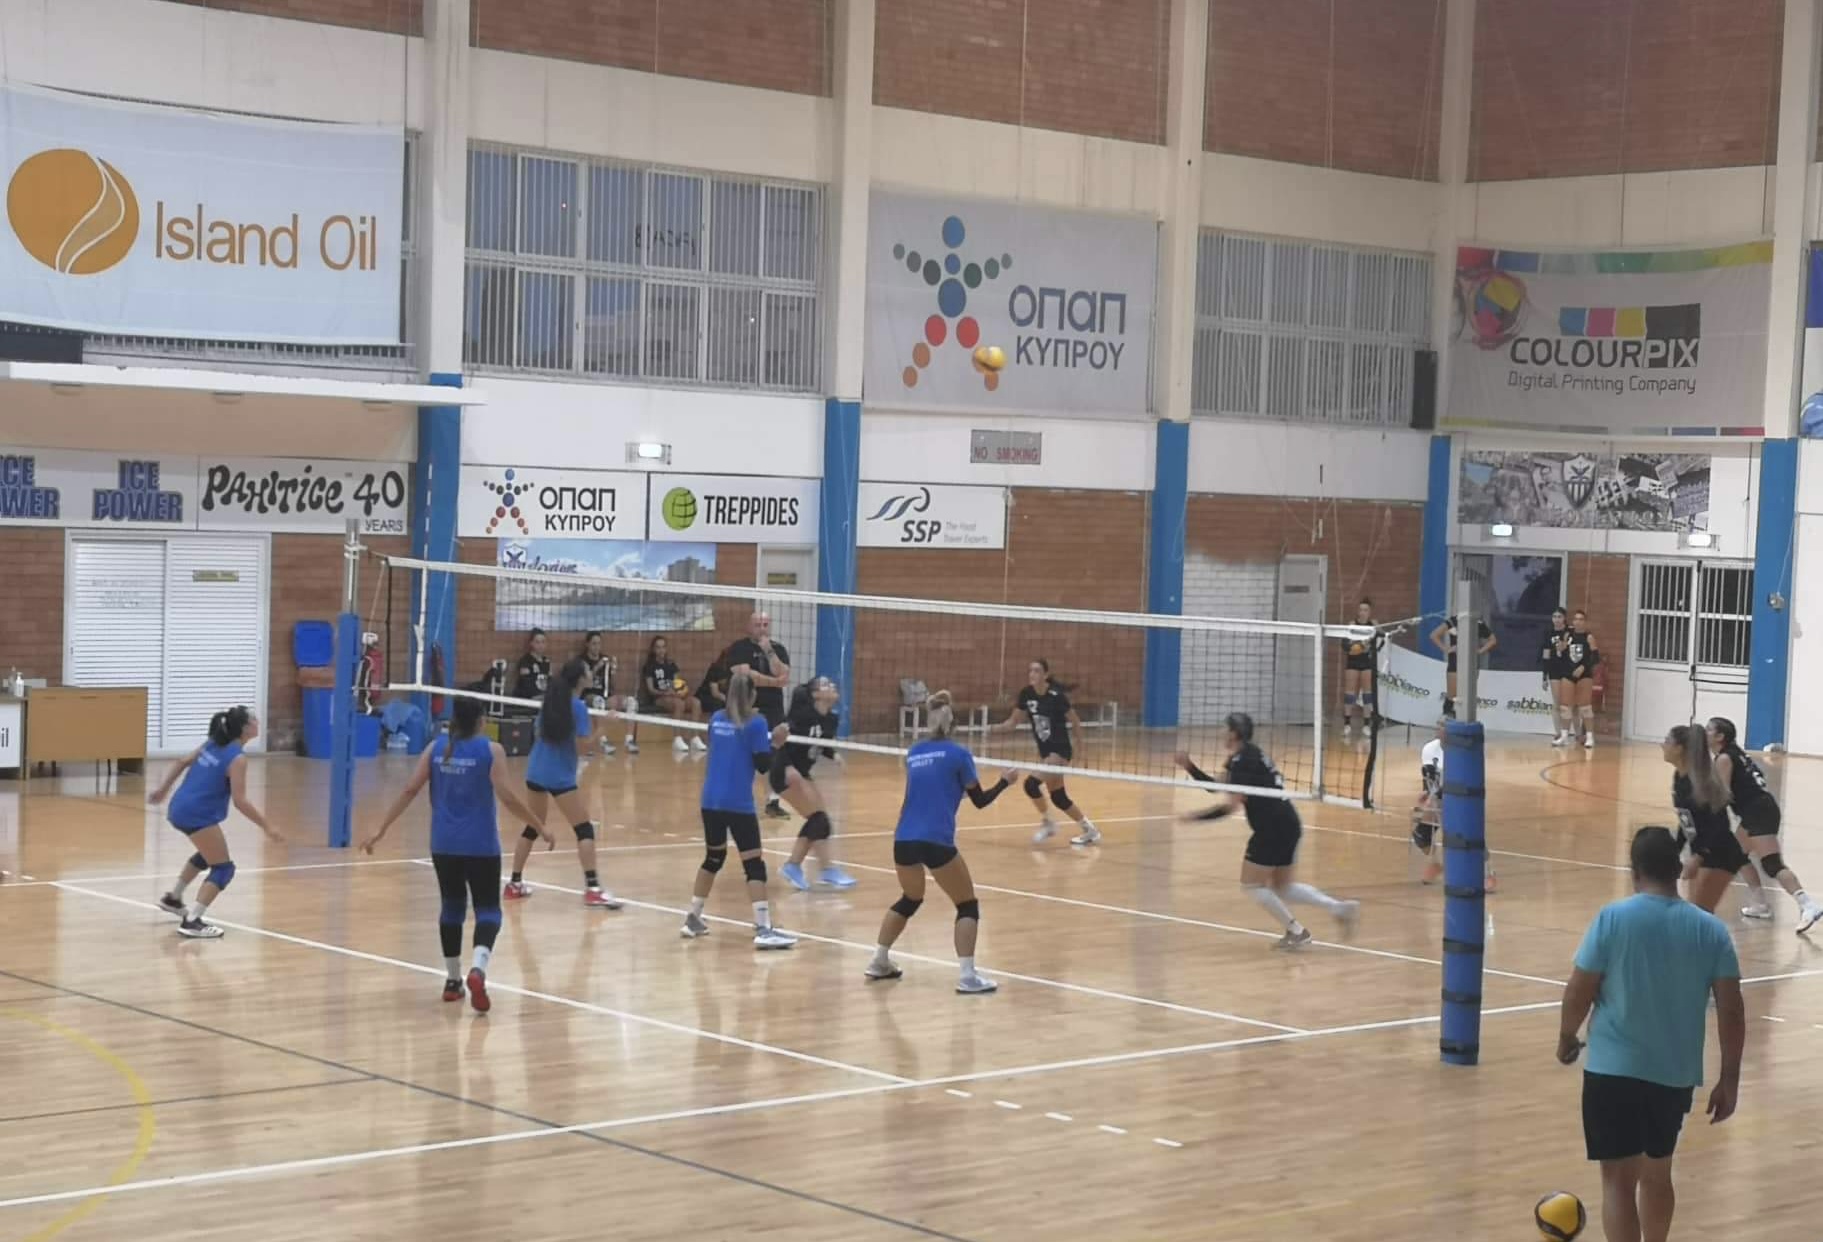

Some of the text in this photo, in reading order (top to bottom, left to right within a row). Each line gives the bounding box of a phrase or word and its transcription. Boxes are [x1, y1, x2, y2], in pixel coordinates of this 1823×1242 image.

[155, 201, 377, 271] Island Oil
[1016, 335, 1125, 370] ΚΥΠΡΟΥ
[1510, 337, 1700, 368] COLOURPIX
[1507, 370, 1697, 396] Digital Printing Company
[975, 446, 1038, 461] NO SMOKING
[0, 456, 35, 487] CE
[118, 460, 160, 490] ICE
[0, 487, 60, 519] WER
[92, 488, 183, 522] POWER
[352, 470, 405, 517] 40
[364, 519, 404, 532] YEARS
[545, 514, 616, 532] ΚΥΠΡΟΥ
[704, 495, 799, 526] TREPPIDES
[901, 520, 942, 543] SSP
[1506, 697, 1553, 710] sabbian
